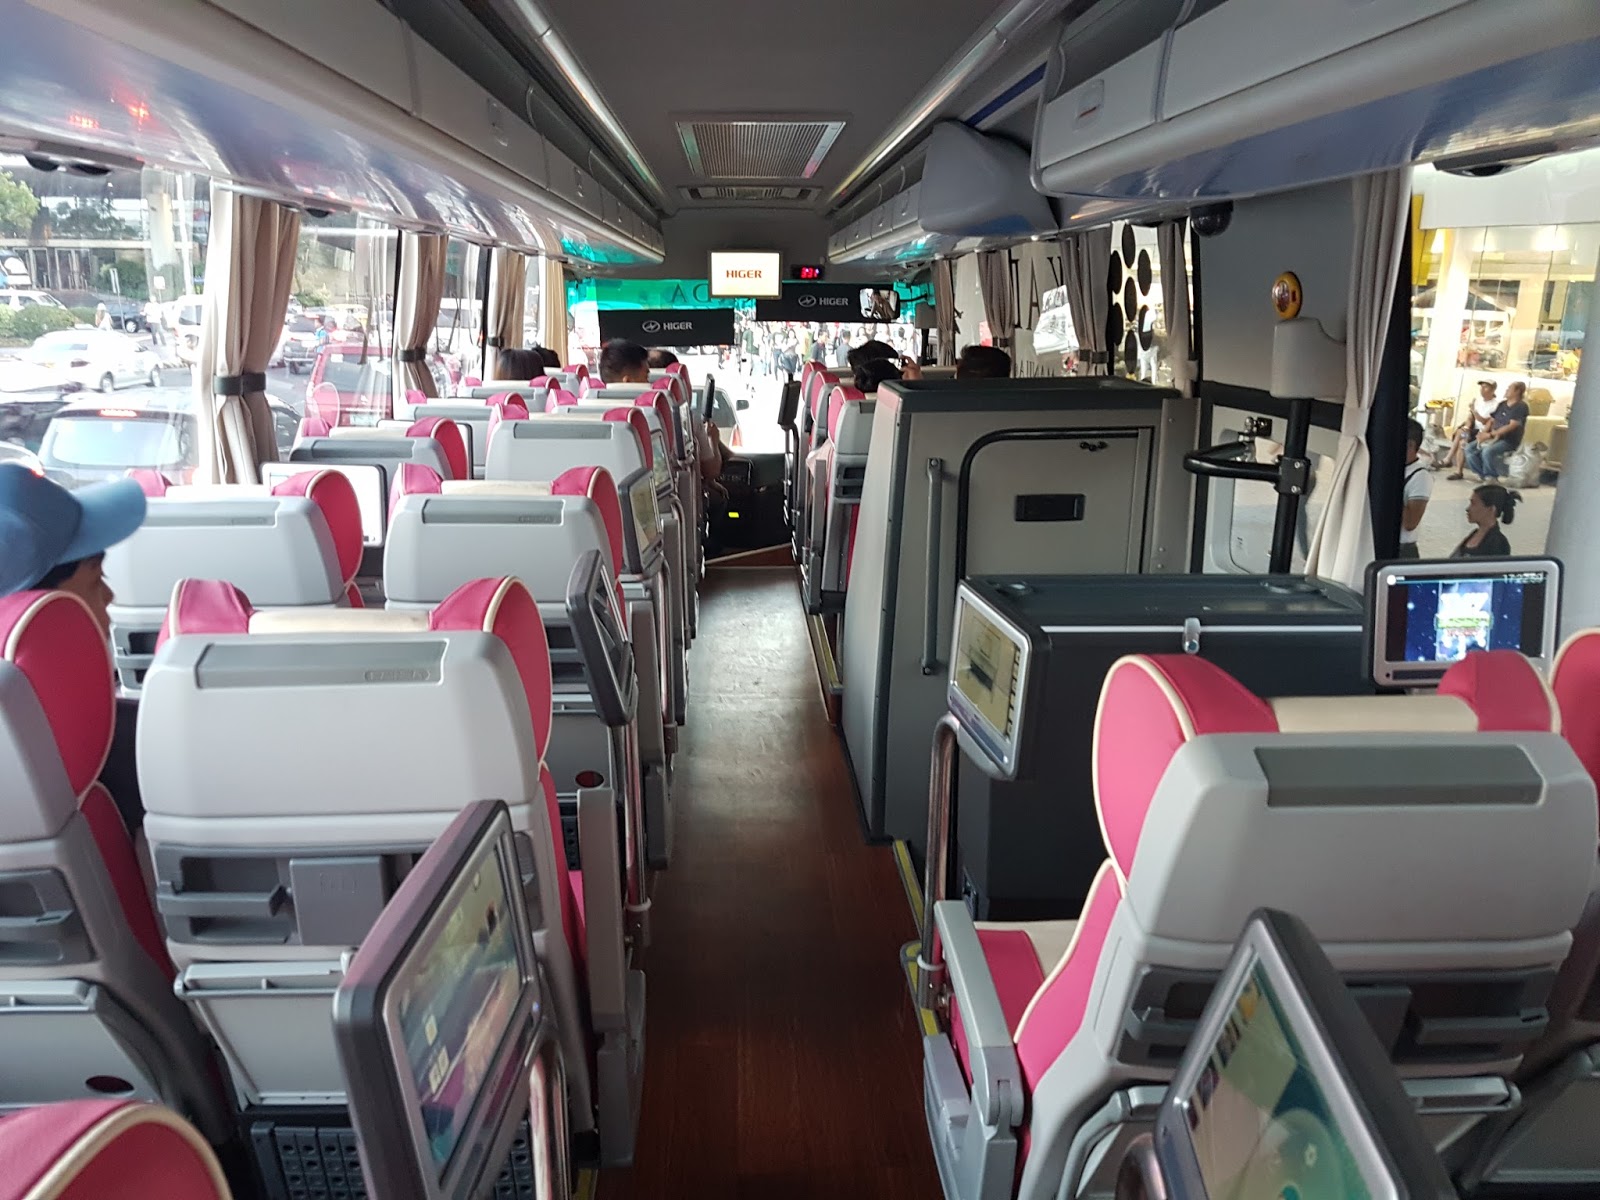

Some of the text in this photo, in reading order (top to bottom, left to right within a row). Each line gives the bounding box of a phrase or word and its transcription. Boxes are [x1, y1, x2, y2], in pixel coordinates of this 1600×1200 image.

[726, 269, 762, 279] HIGER
[819, 297, 849, 306] HIGER
[663, 322, 693, 331] HIGER
